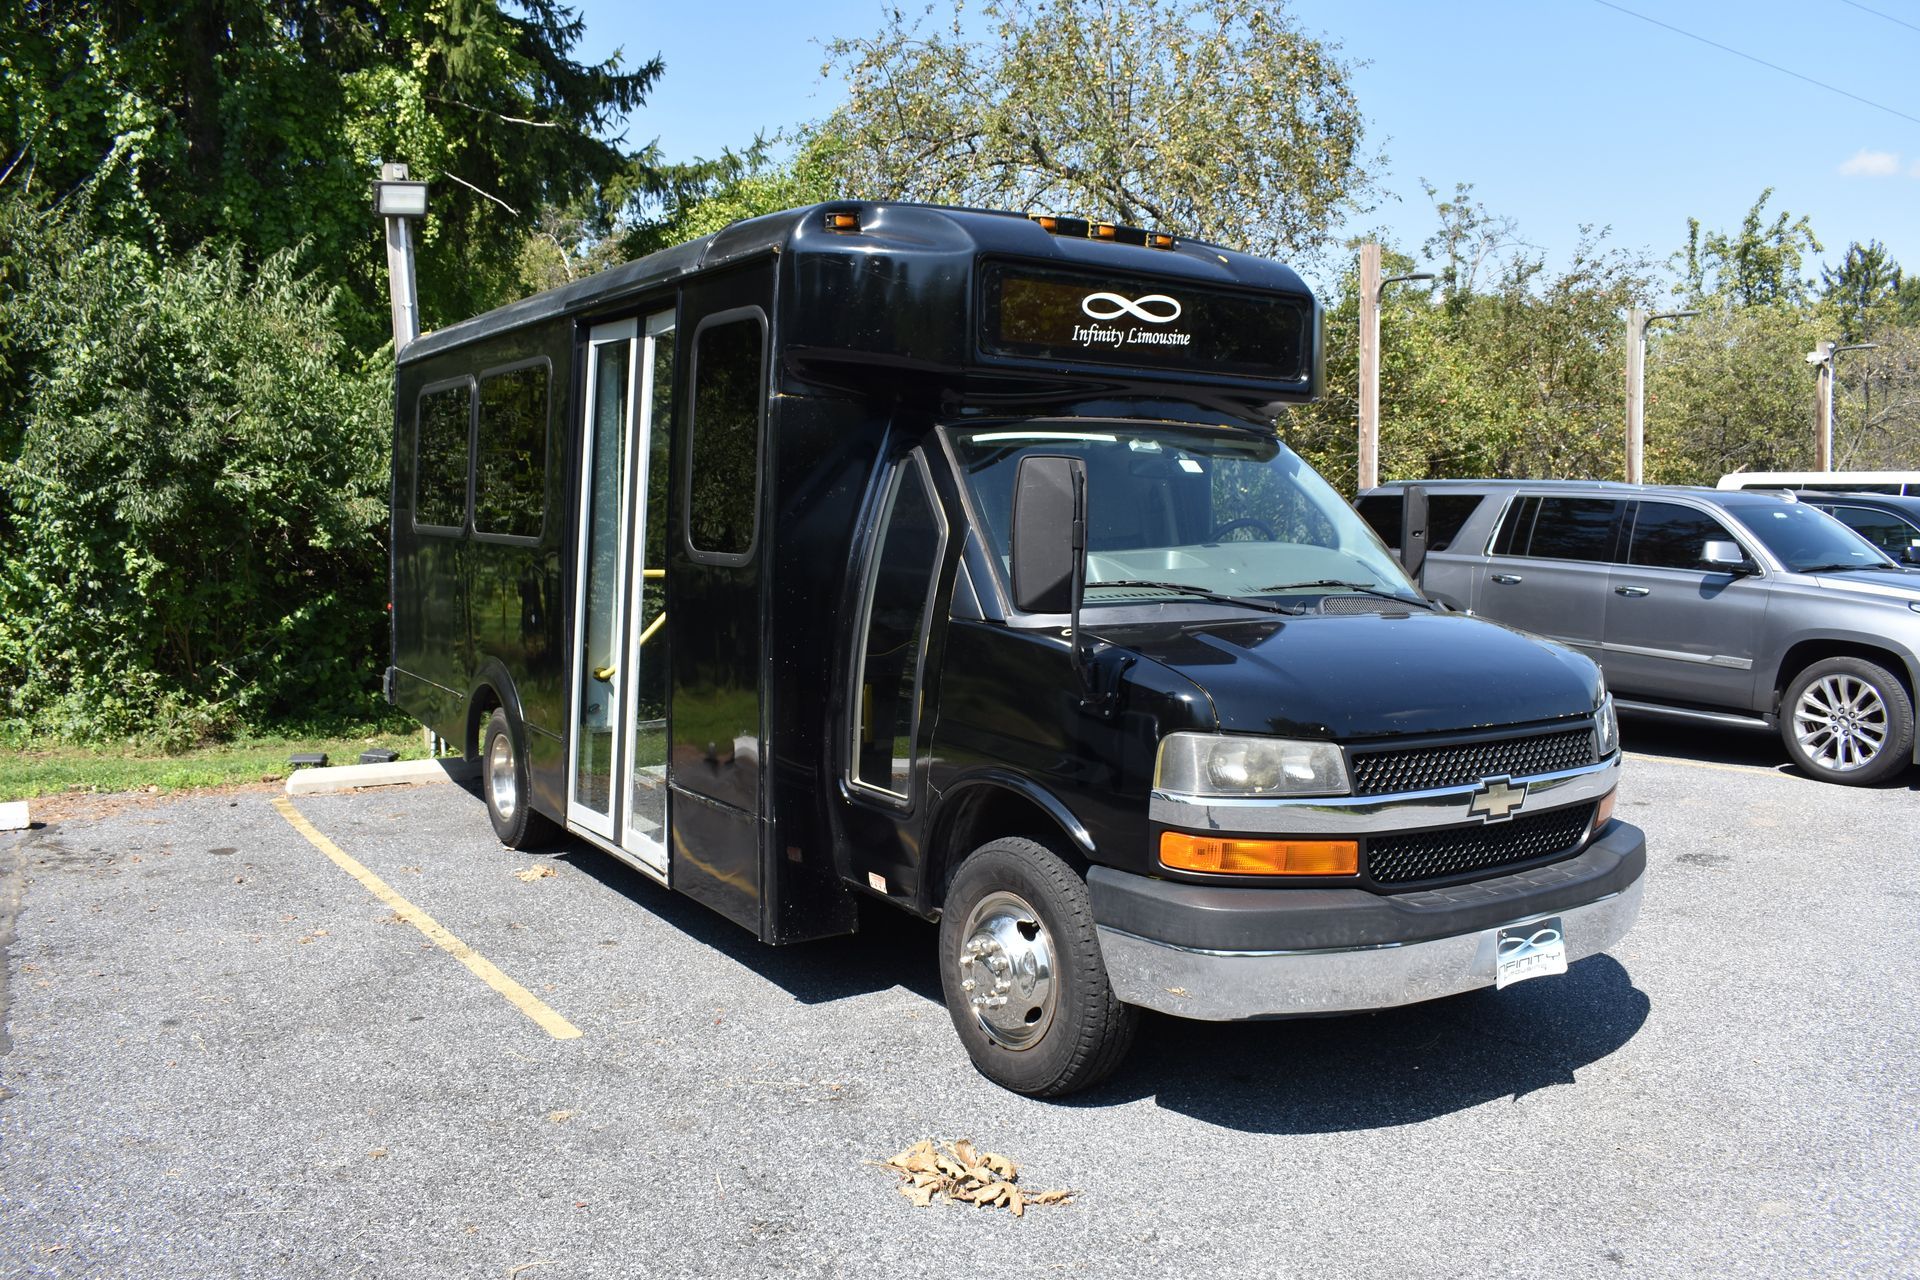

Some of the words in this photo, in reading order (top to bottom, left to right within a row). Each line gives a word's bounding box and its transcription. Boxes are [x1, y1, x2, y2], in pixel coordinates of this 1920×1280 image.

[1072, 323, 1124, 348] Infinity
[1127, 327, 1191, 346] Limousine
[1498, 952, 1560, 975] NFINITY
